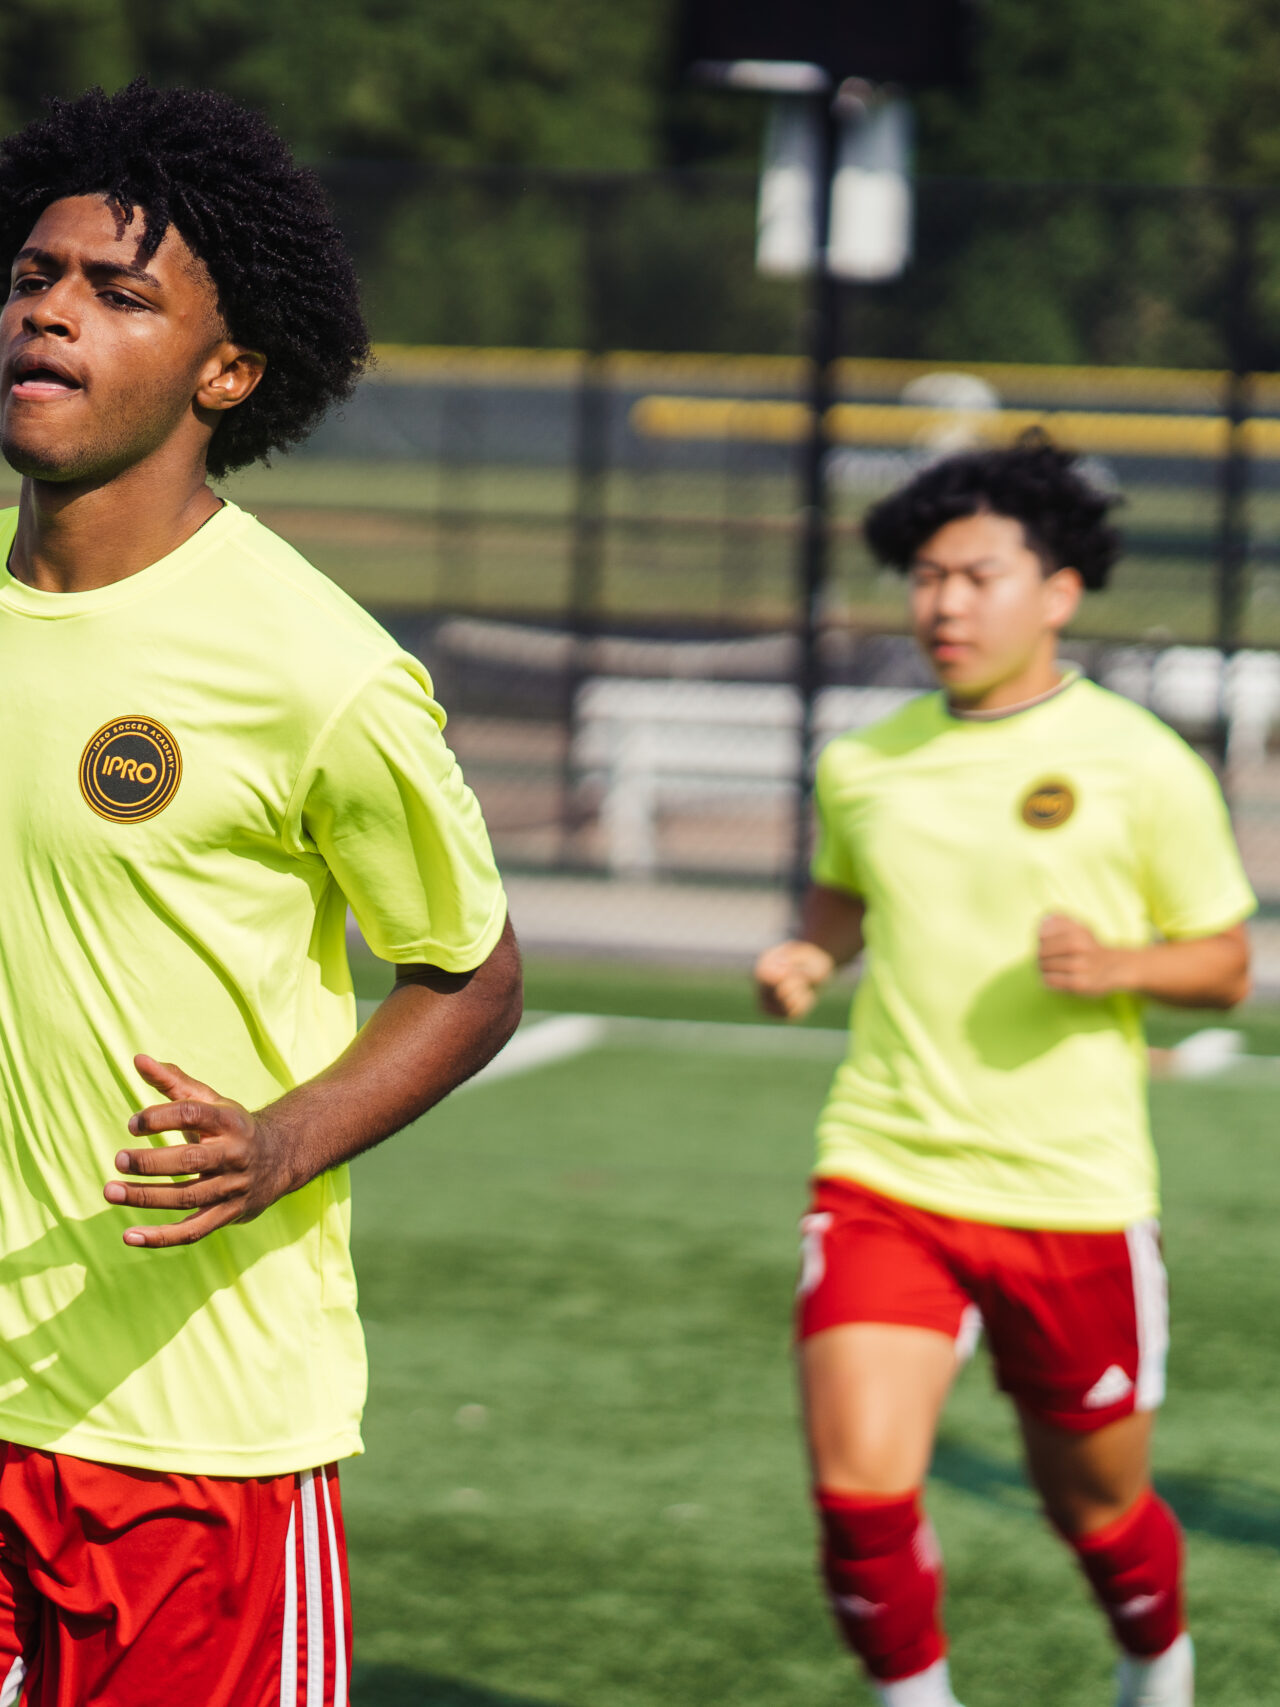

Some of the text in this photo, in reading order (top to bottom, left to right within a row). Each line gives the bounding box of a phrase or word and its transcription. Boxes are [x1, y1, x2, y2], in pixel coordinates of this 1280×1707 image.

[92, 723, 175, 769] IPRO SOCCER ACADEMY
[101, 755, 157, 784] IPRO
